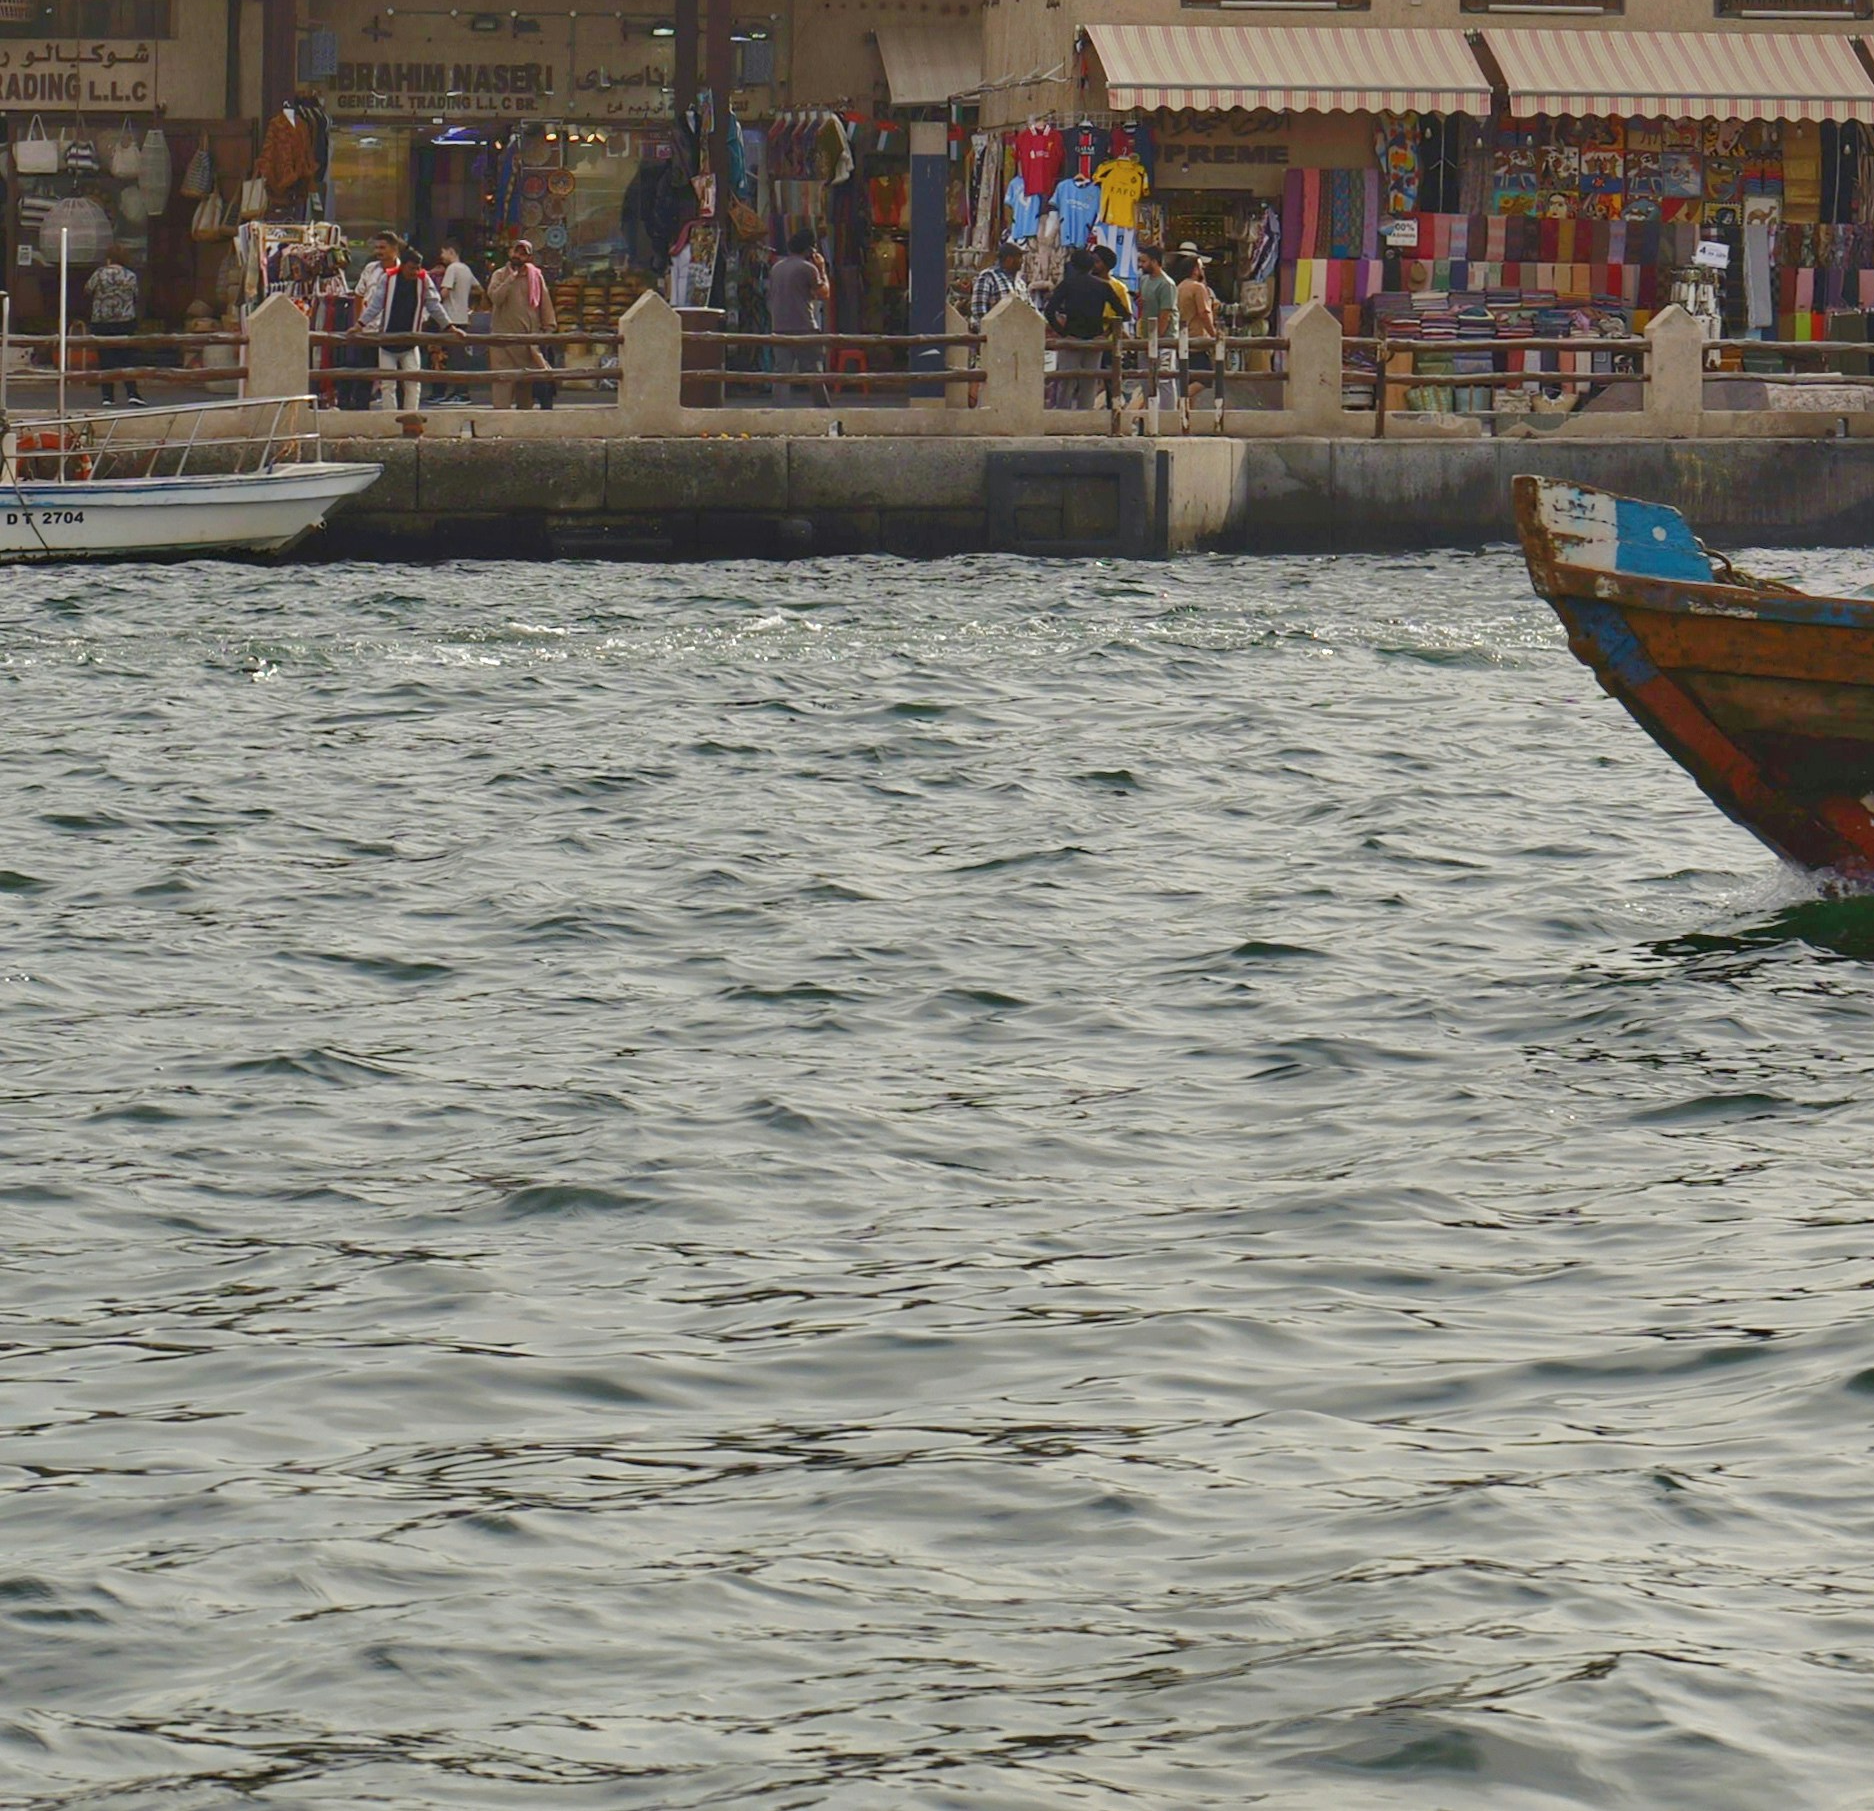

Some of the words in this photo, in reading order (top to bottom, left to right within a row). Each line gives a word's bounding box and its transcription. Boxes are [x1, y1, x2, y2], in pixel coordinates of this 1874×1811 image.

[0, 73, 81, 101] ADING
[337, 95, 402, 109] GENERAL
[408, 95, 471, 109] TRADING
[1156, 145, 1289, 164] PREME
[42, 511, 84, 525] 2704
